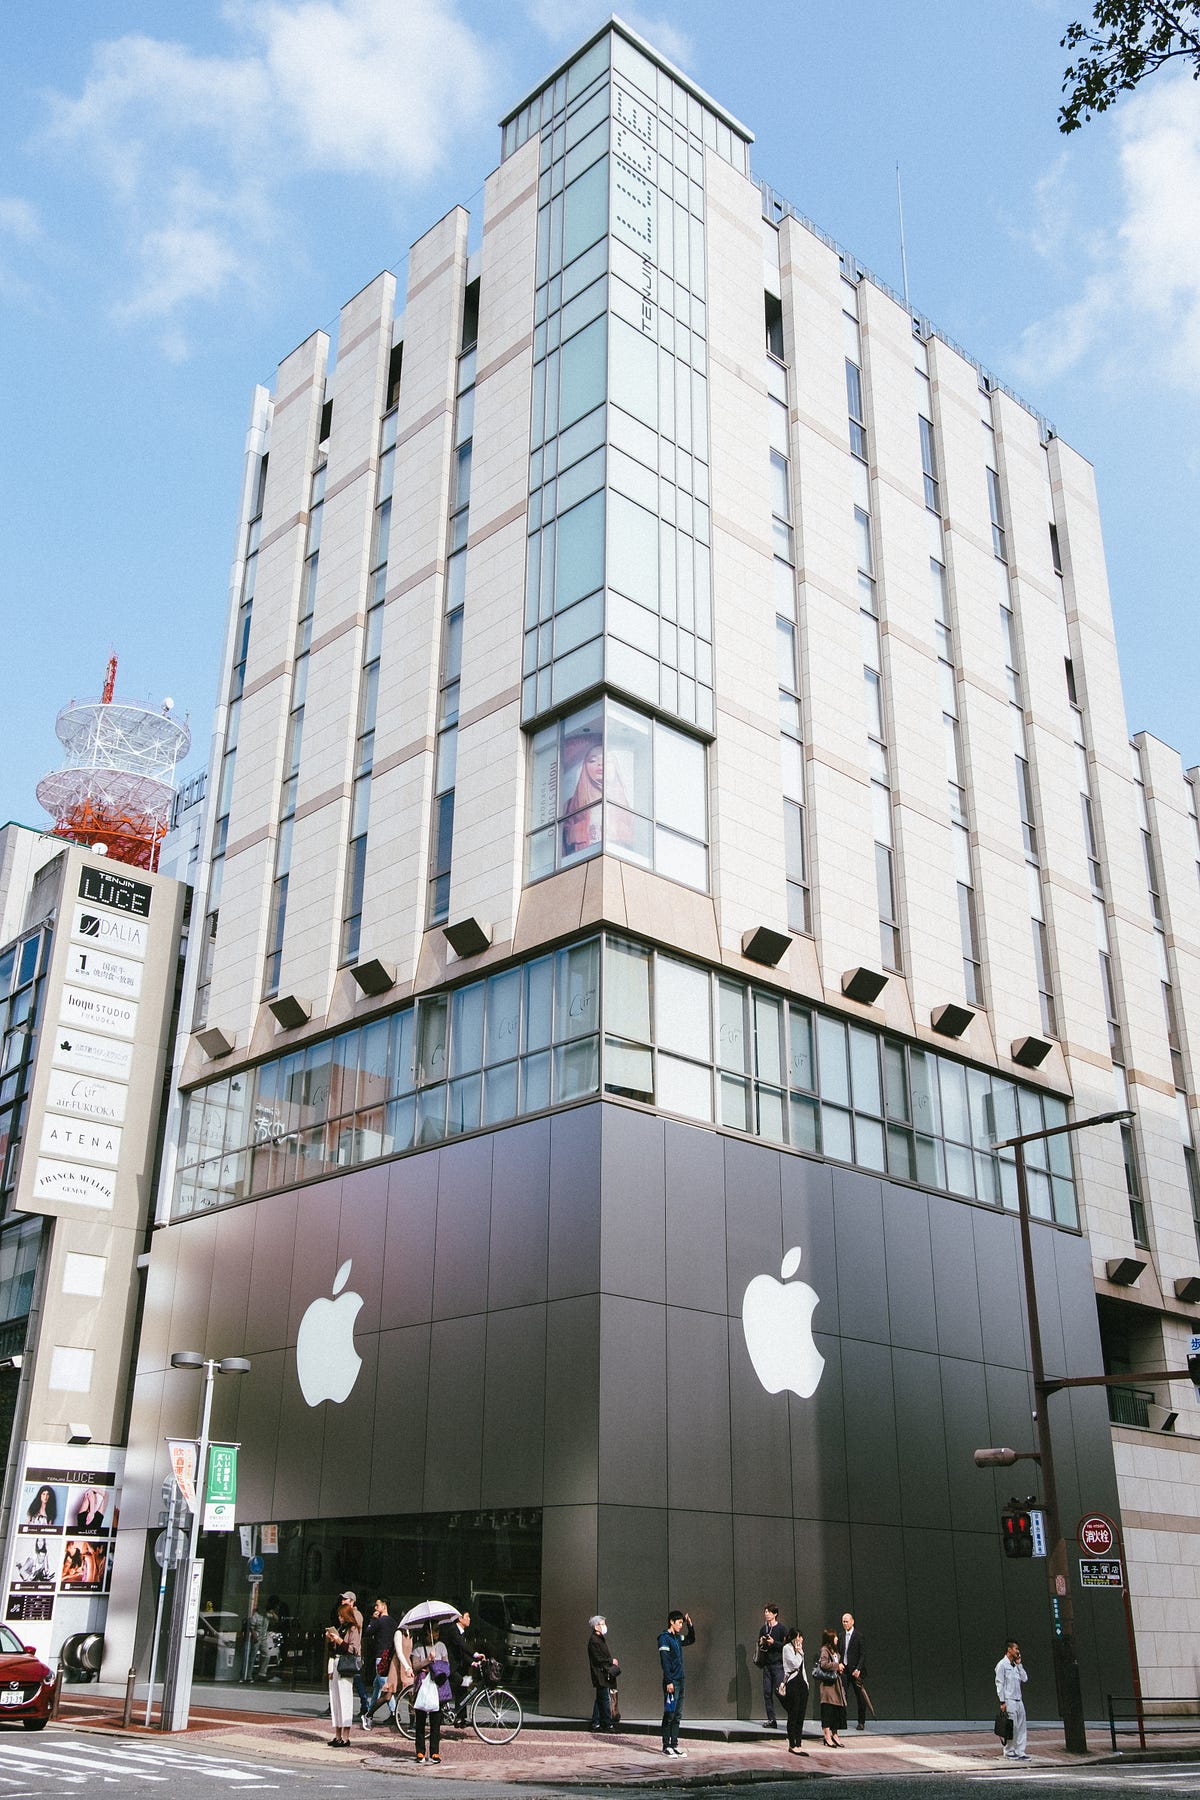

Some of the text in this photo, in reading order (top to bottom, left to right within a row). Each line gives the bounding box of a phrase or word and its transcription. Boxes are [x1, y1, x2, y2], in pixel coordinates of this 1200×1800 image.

[616, 91, 653, 332] TENJIN LUCE
[98, 872, 135, 889] TENJIN
[84, 878, 146, 914] LUCE
[101, 919, 141, 945] DALIA
[79, 954, 87, 970] 1
[68, 994, 131, 1020] hoyu STUDIO
[50, 1129, 113, 1150] ATENA
[40, 1171, 112, 1198] FRANCK MULLER
[66, 1471, 96, 1484] LUCE
[1085, 1529, 1110, 1543] 消火栓
